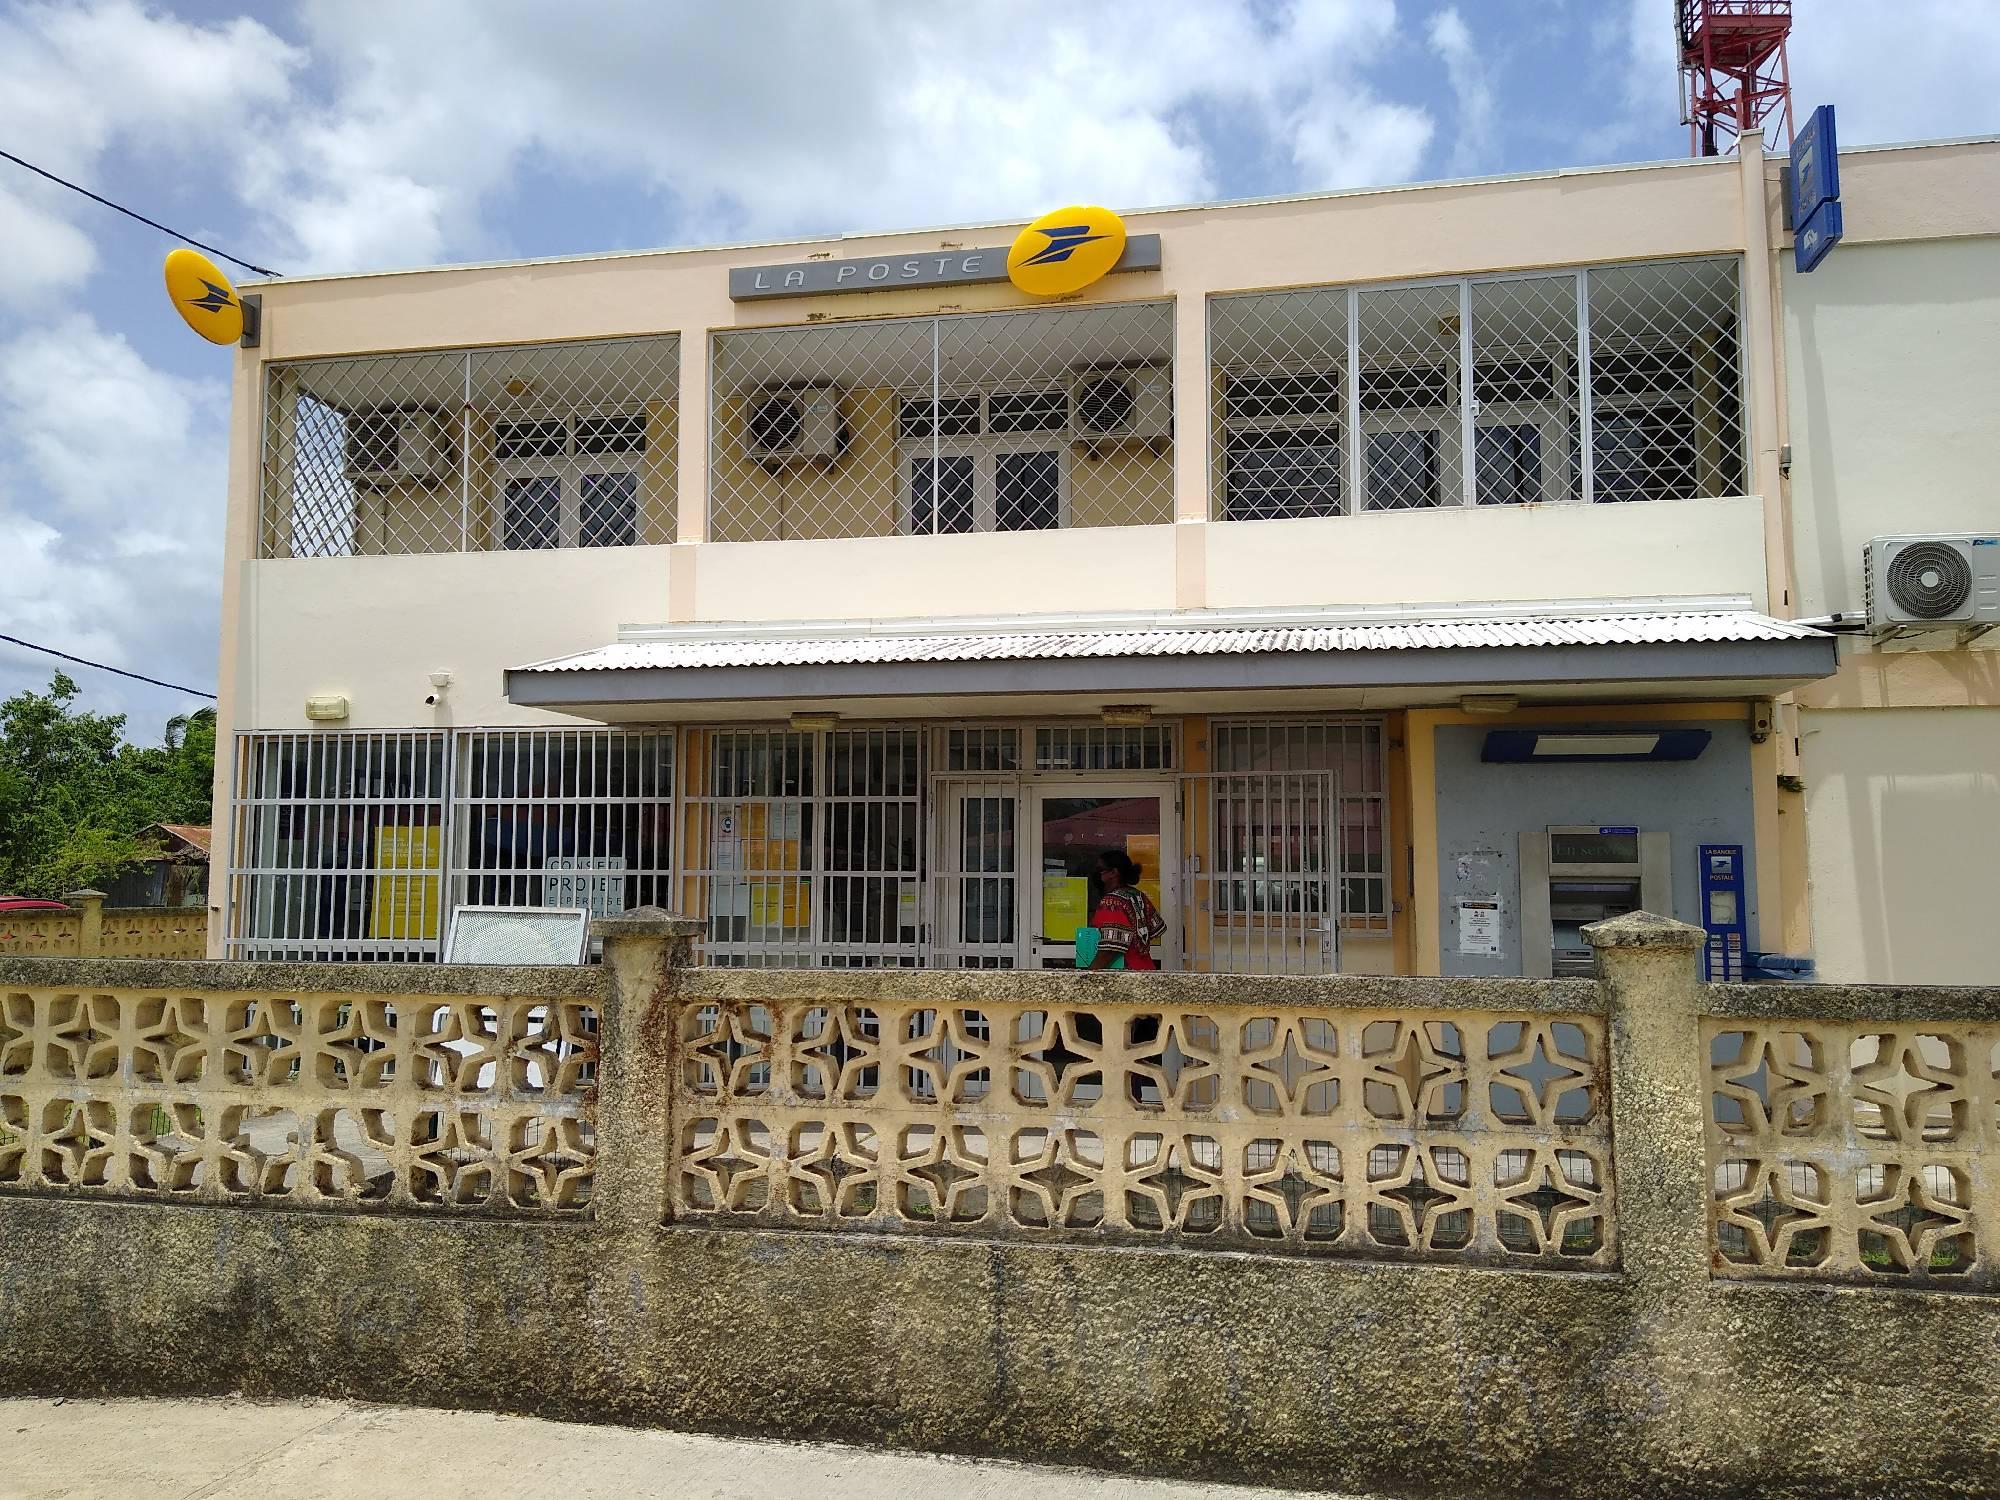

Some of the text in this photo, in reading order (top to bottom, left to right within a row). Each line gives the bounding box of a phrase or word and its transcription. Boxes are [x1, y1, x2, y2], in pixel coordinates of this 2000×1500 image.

[754, 255, 983, 290] LA POSTE
[549, 877, 623, 892] PROJET
[548, 896, 622, 905] EPERTISE
